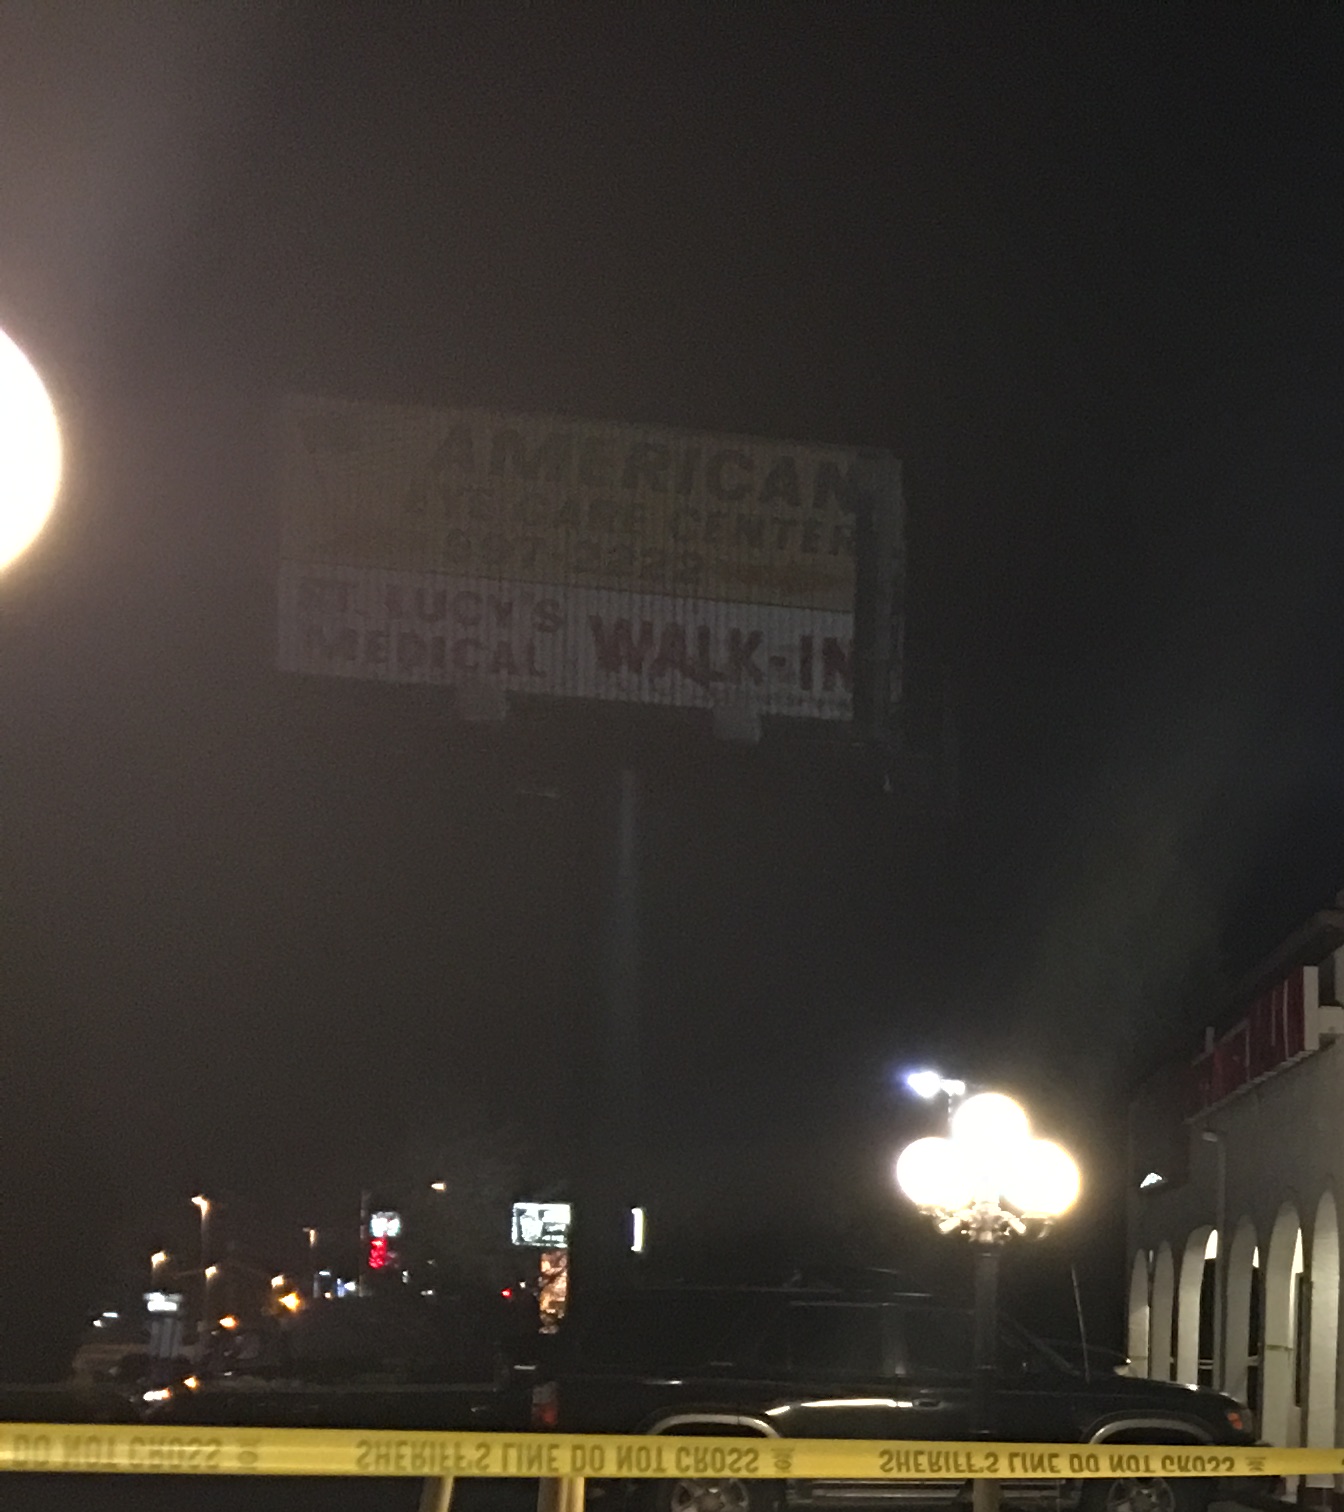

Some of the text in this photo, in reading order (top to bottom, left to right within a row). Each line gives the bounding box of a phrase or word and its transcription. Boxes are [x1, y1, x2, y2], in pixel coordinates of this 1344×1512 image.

[430, 422, 859, 513] AMERICAN
[514, 491, 649, 536] CARE
[670, 506, 856, 557] CENTER
[385, 584, 567, 635] LUCY'S
[303, 614, 855, 695] MEDICAL WALK-IN
